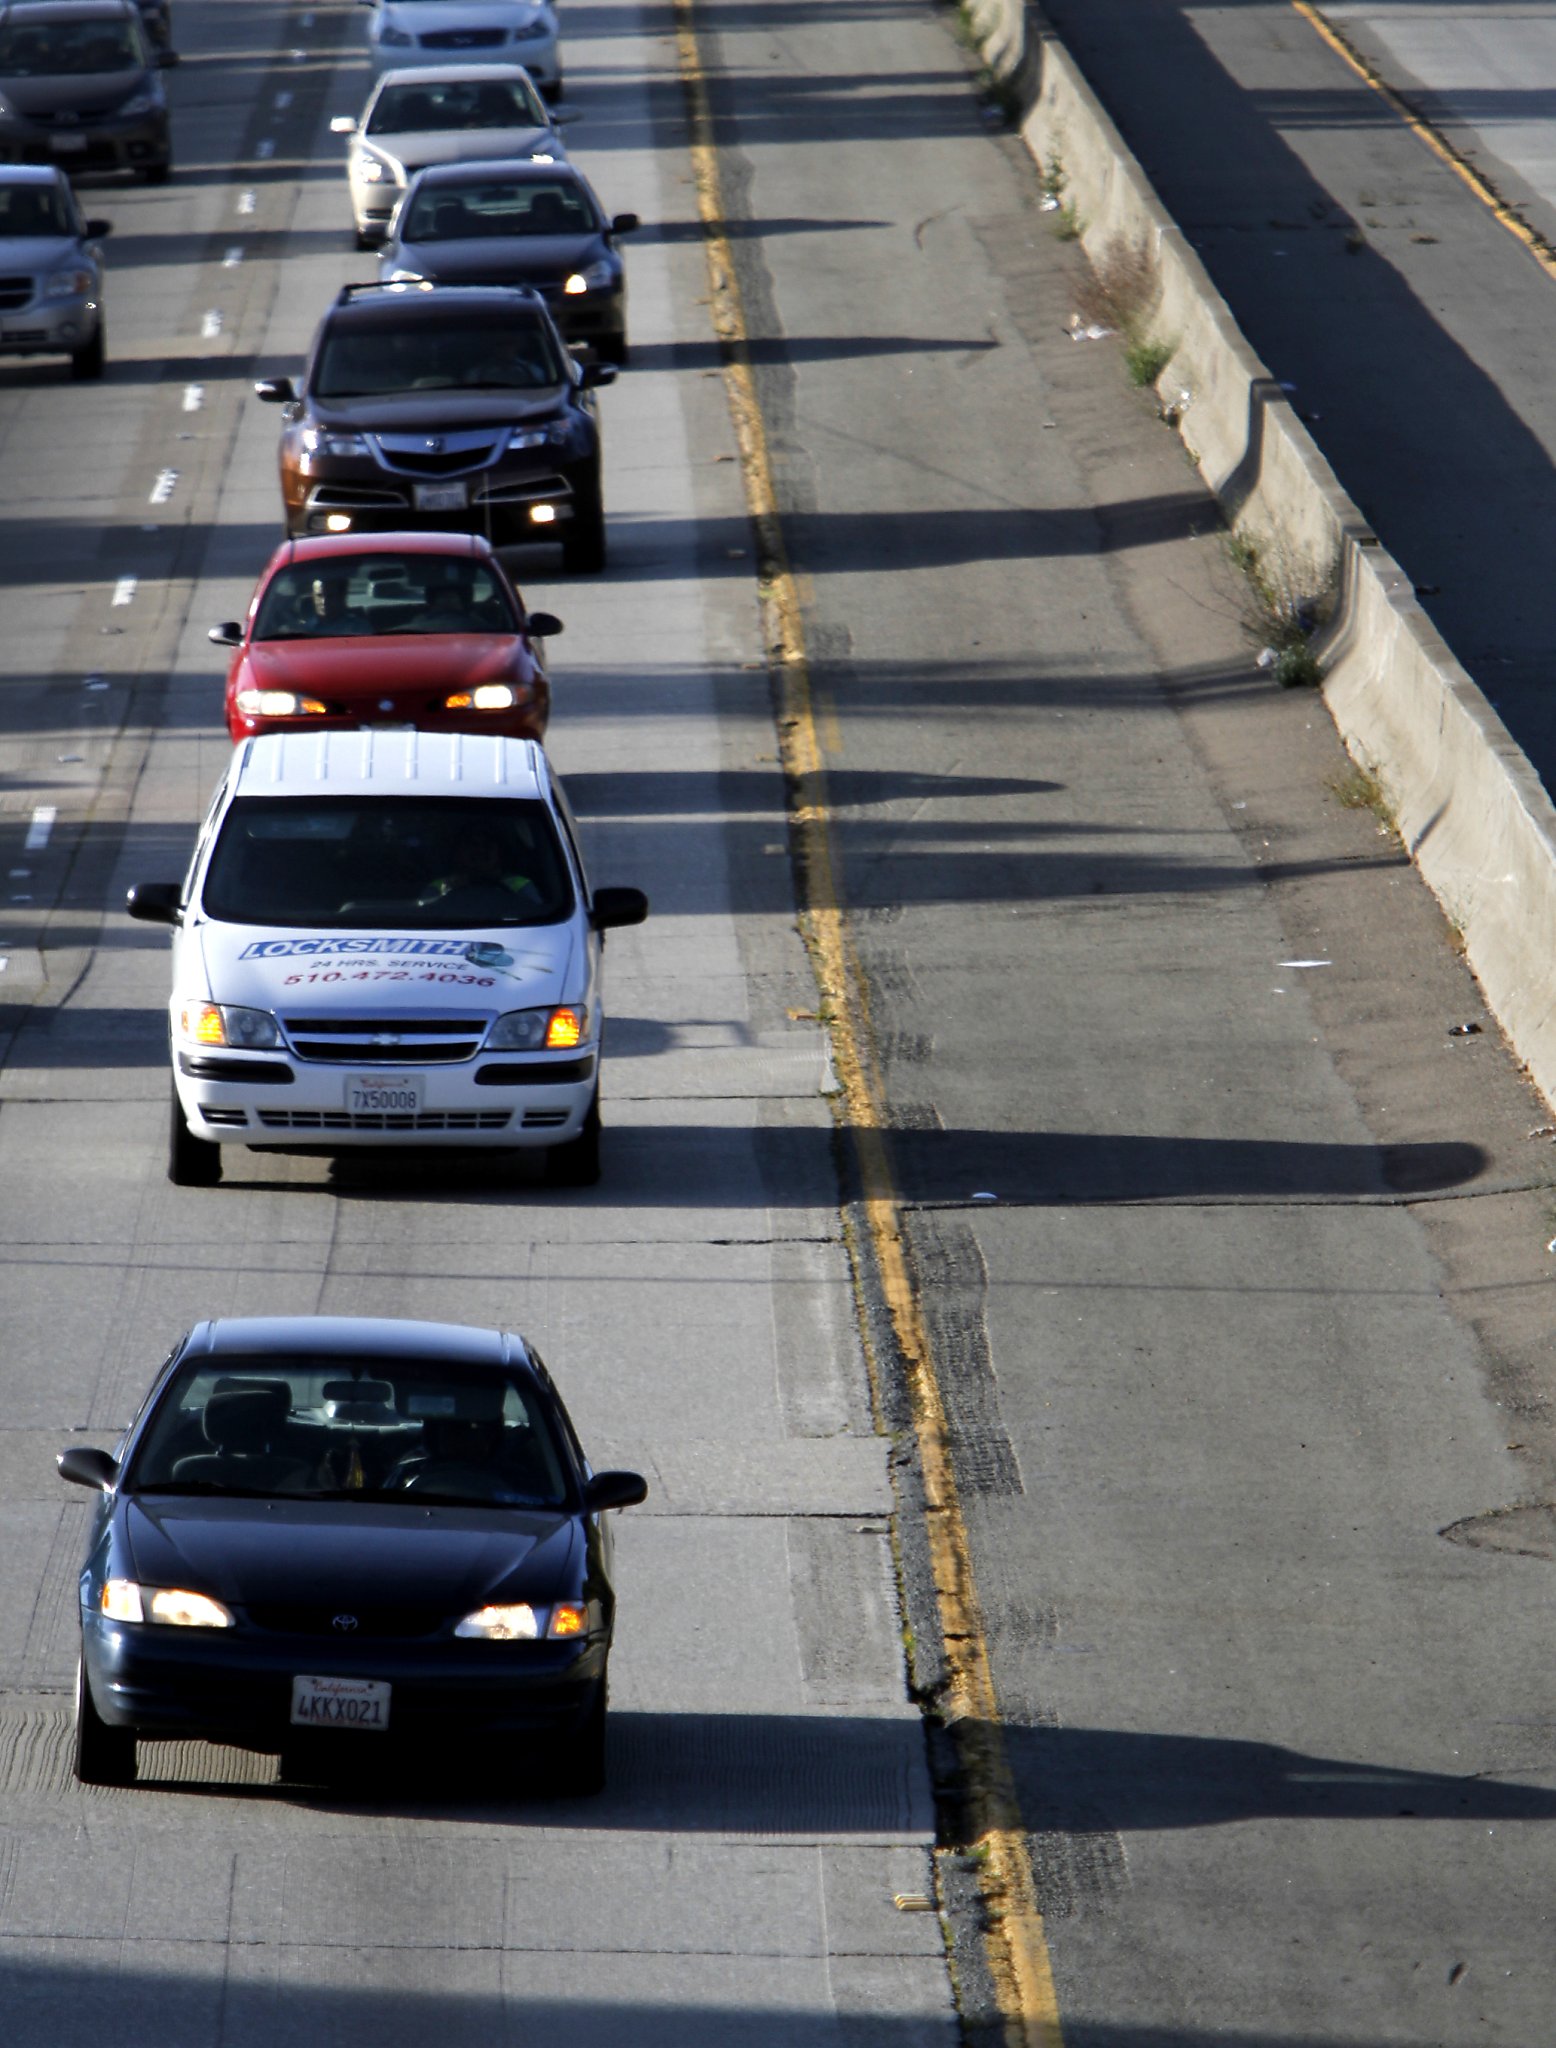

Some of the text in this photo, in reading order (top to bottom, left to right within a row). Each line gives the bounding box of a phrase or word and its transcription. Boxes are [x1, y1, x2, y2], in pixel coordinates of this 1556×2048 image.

[243, 938, 470, 958] LOCKSMITH
[310, 961, 332, 969] 24
[388, 959, 469, 971] SERVICE
[284, 970, 497, 987] 510.472.4036
[297, 1695, 382, 1724] 4KKX021
